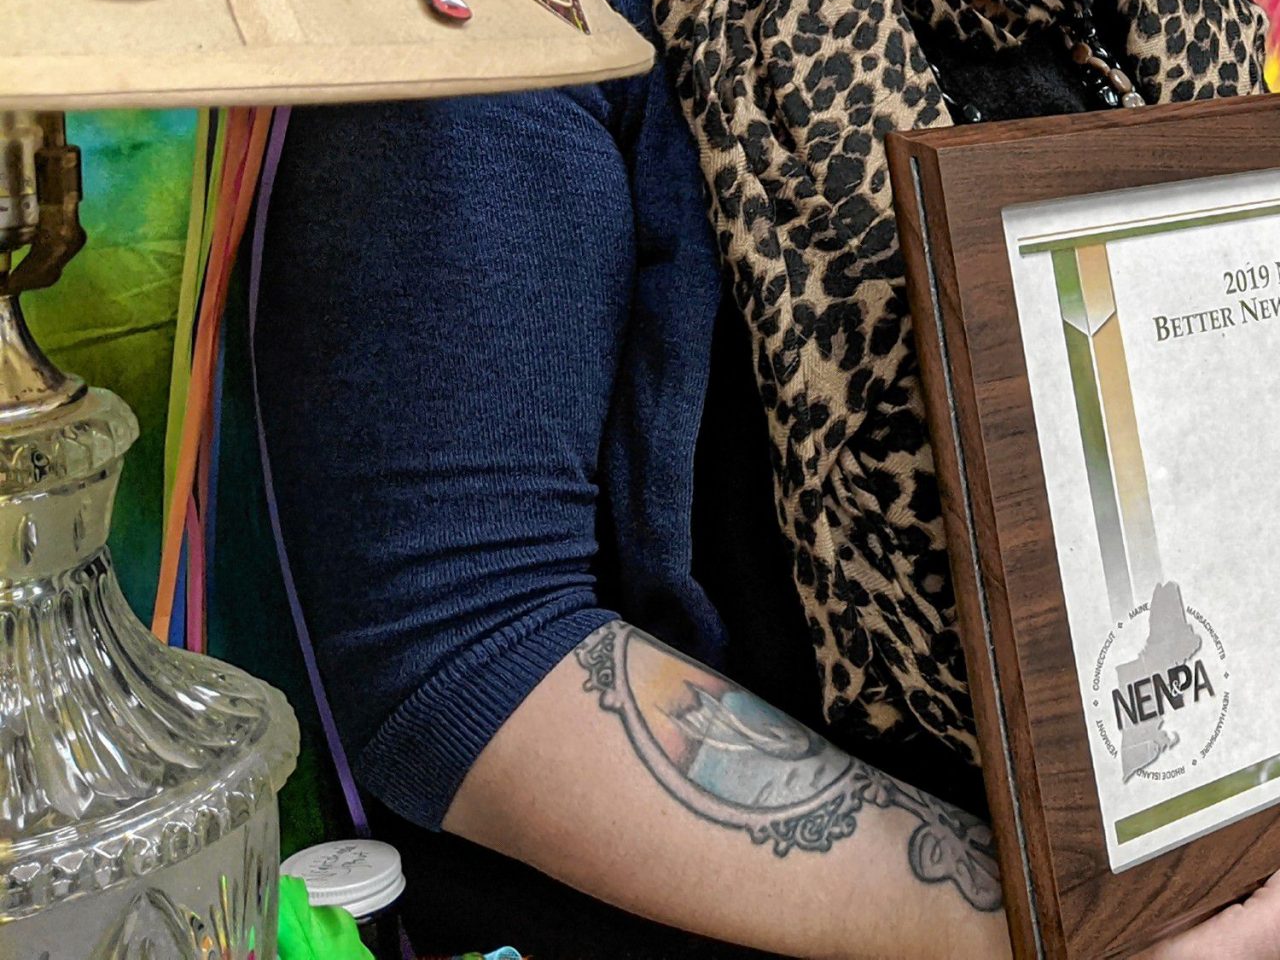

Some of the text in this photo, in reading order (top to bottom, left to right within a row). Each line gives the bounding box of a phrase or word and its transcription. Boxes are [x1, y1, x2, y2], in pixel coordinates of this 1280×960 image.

[1223, 264, 1270, 295] 2019
[1127, 602, 1227, 662] MAINE MASSACHUSETTS
[1092, 630, 1117, 692] CONNECTICUT
[1095, 718, 1119, 760] VERMONT
